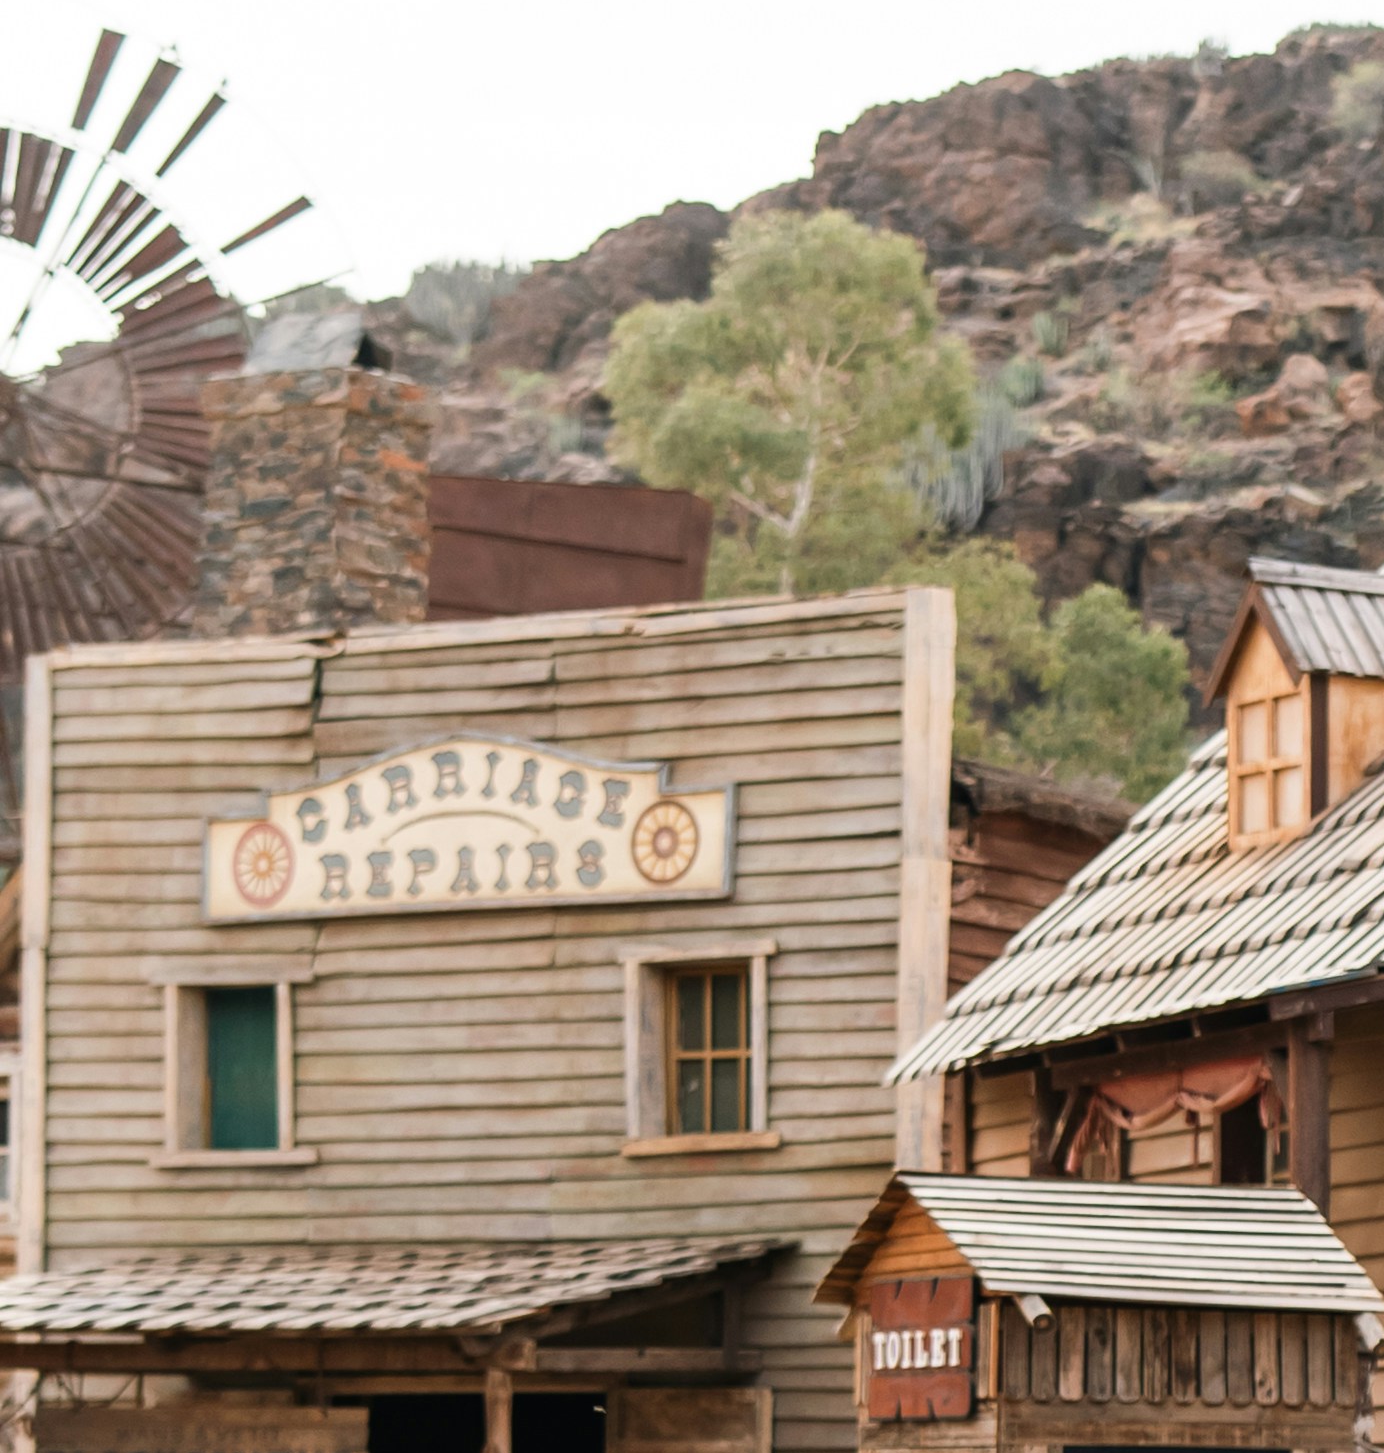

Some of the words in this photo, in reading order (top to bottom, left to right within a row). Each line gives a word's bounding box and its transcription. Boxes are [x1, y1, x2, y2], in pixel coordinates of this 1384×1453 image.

[297, 750, 631, 843] CARRIAGE
[319, 839, 607, 901] REPAIRS
[872, 1328, 963, 1370] TOILET
